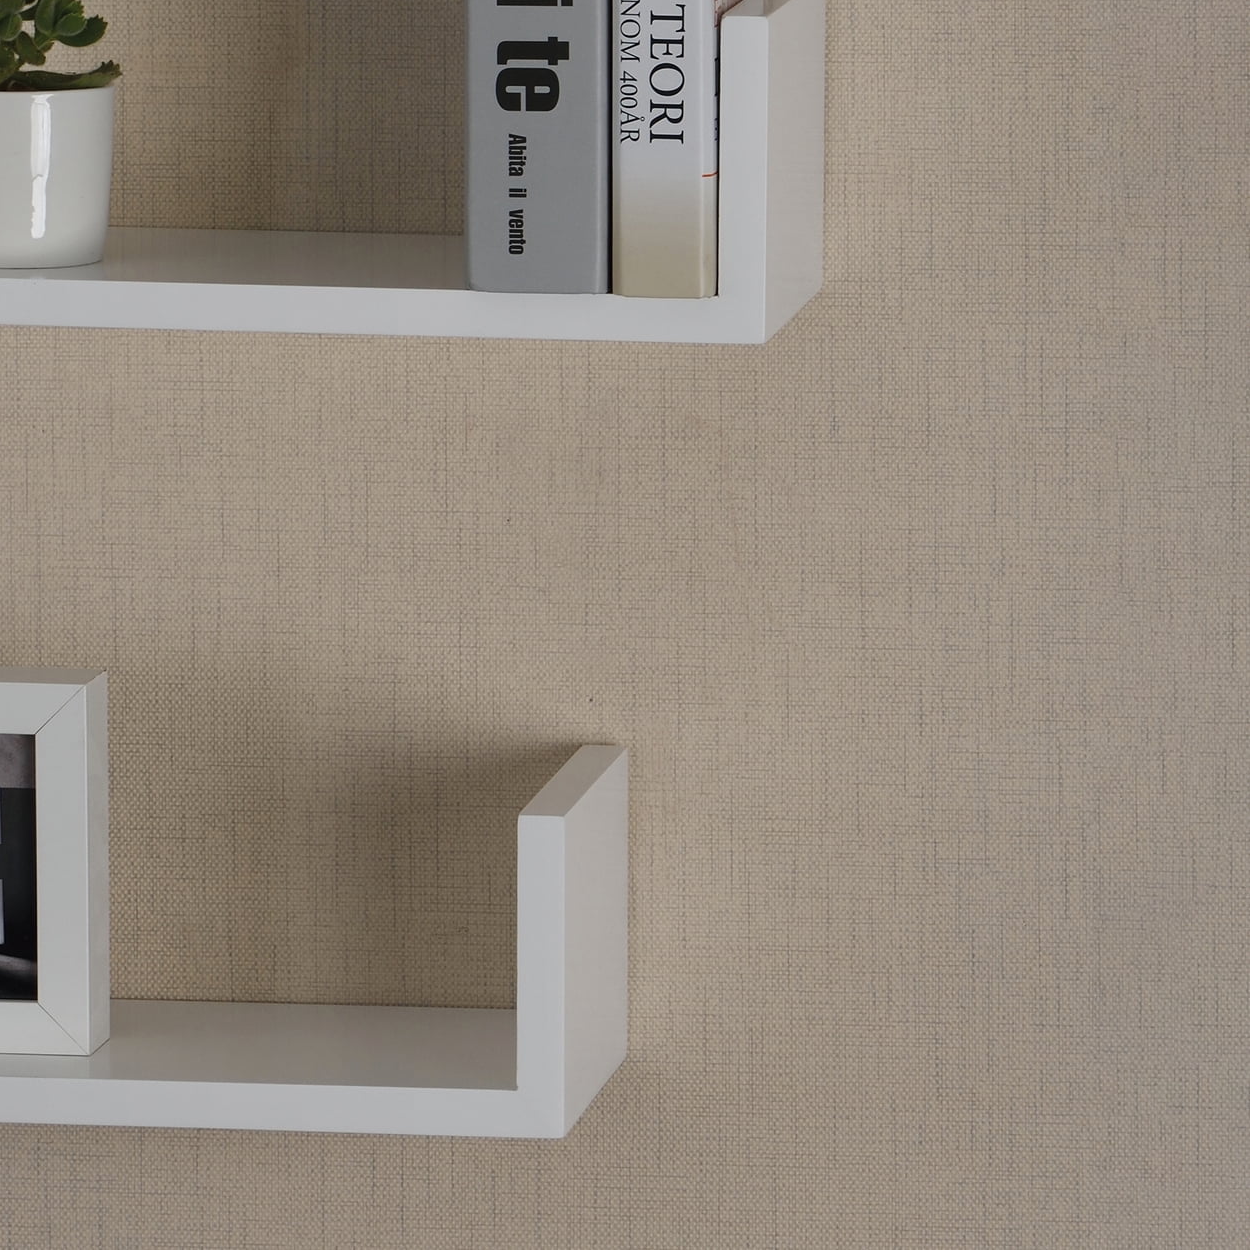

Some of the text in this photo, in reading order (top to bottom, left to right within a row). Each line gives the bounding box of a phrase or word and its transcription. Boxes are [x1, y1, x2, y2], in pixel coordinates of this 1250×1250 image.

[495, 36, 570, 111] te
[619, 70, 646, 144] 400ÅR
[649, 3, 685, 145] TEORI
[508, 133, 527, 255] Abita il vento
